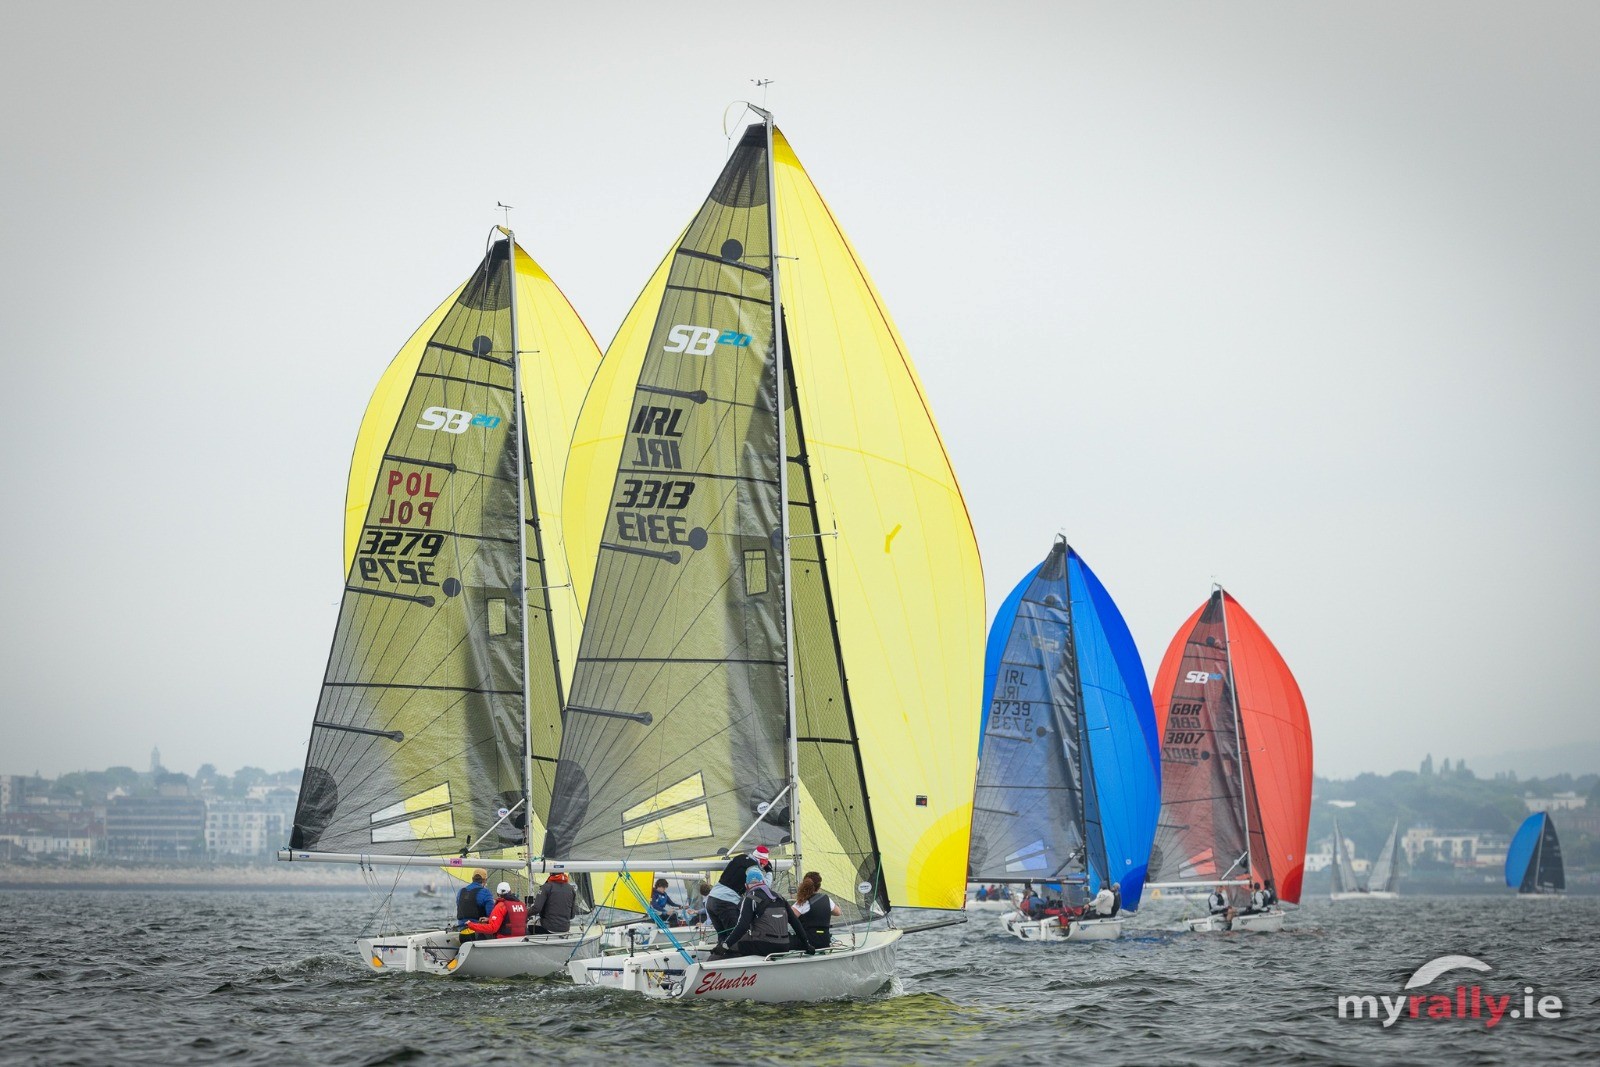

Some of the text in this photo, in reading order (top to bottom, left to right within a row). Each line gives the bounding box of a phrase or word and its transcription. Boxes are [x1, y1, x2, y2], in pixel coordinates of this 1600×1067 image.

[663, 324, 752, 356] SB20
[632, 405, 683, 437] IRL
[387, 470, 440, 498] POL
[615, 479, 695, 510] 3313
[359, 531, 445, 558] 3279
[1004, 669, 1028, 686] IRL
[993, 701, 1031, 716] 3739
[1171, 703, 1203, 716] GBR
[1166, 732, 1205, 744] 3807
[511, 904, 525, 913] HH
[695, 969, 758, 995] Elandra
